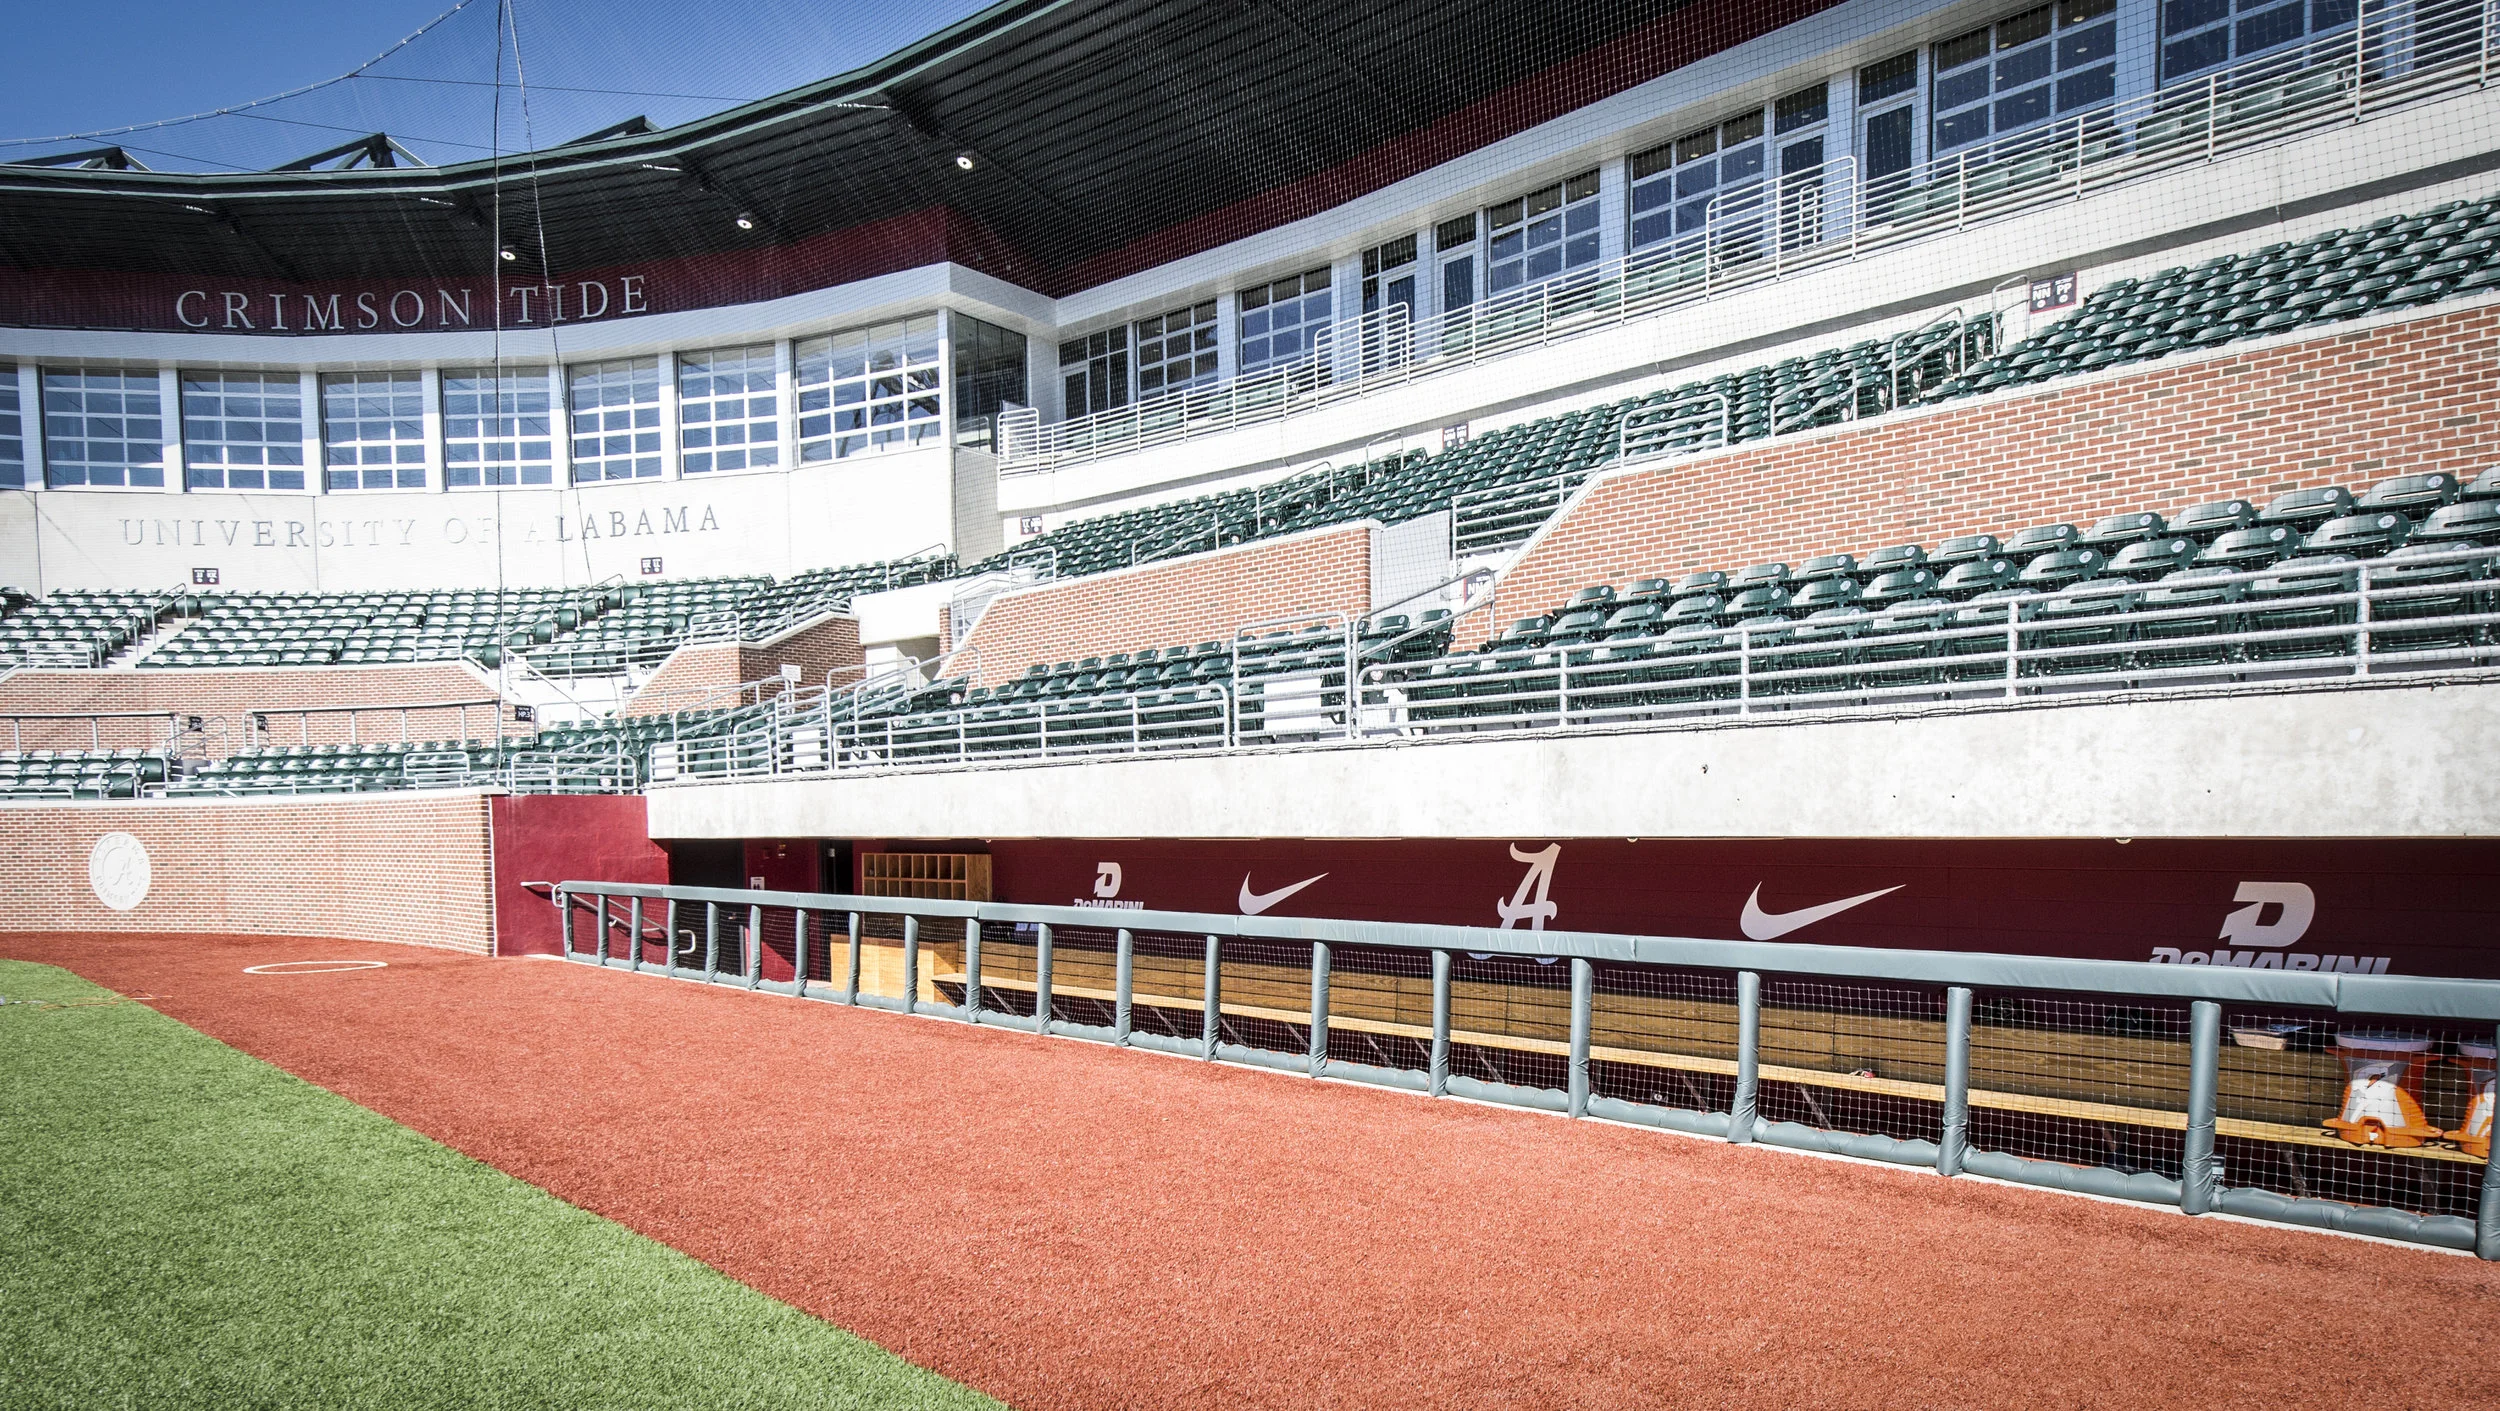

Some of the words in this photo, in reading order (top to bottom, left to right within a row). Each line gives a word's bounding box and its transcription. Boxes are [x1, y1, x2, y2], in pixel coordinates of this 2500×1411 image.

[175, 289, 471, 331] CRIMSON
[510, 274, 648, 324] TIDE
[2032, 287, 2051, 301] NN
[2056, 282, 2073, 296] PP
[118, 518, 417, 548] UNIVERSITY
[444, 516, 497, 545] OF
[523, 503, 721, 544] ALABAMA
[2218, 881, 2316, 948] D
